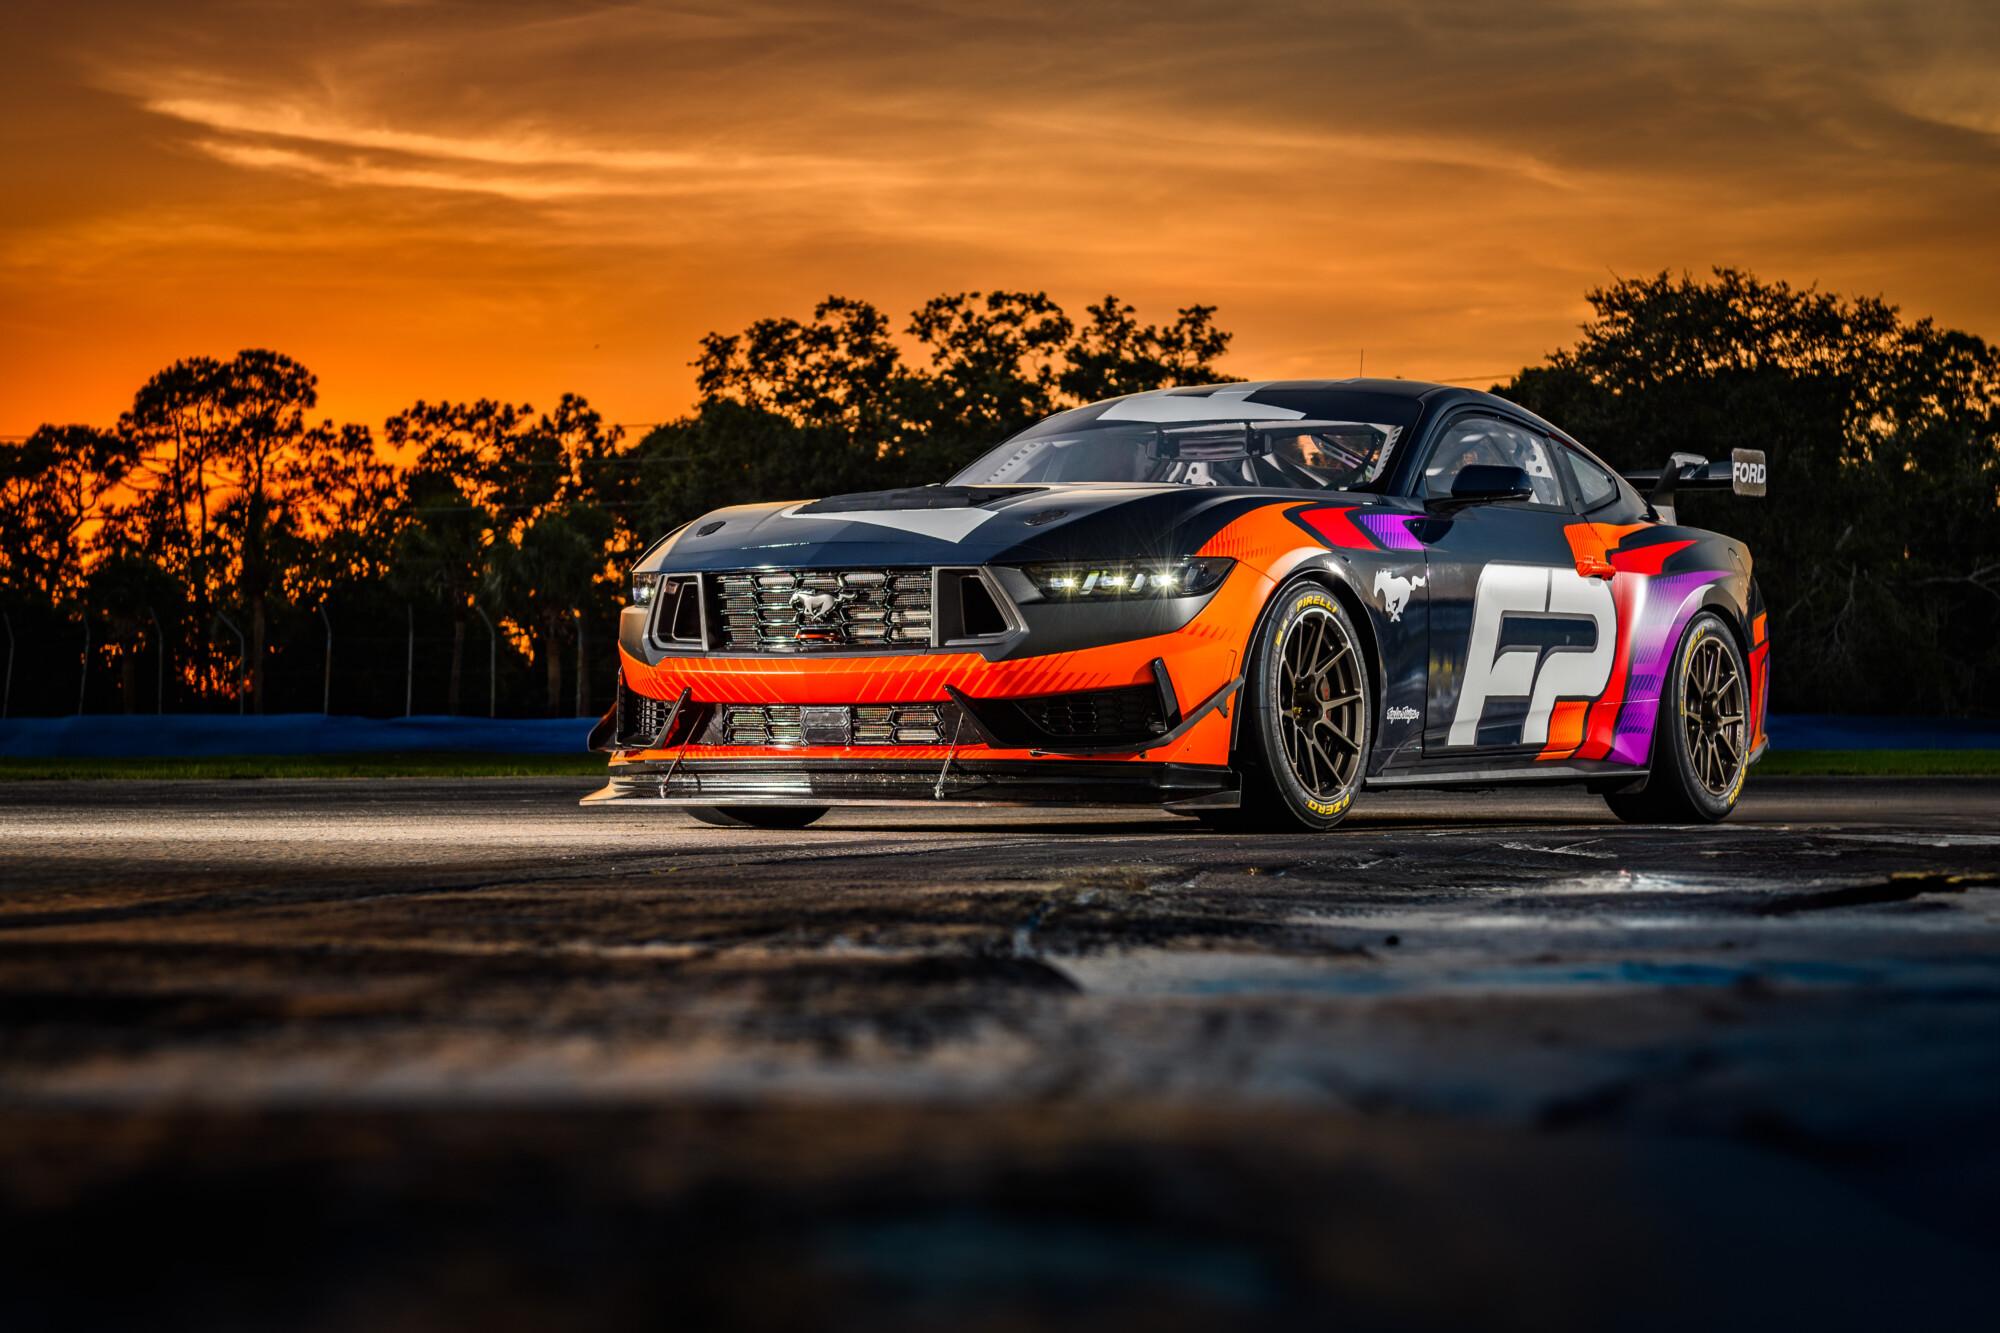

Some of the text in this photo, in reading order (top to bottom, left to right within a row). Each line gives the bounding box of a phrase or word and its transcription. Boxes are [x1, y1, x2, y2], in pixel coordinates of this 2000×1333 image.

[1733, 461, 1766, 484] FORD
[1296, 595, 1338, 614] PIRELLI
[1447, 562, 1618, 746] FP
[1307, 793, 1350, 815] P ZERO
